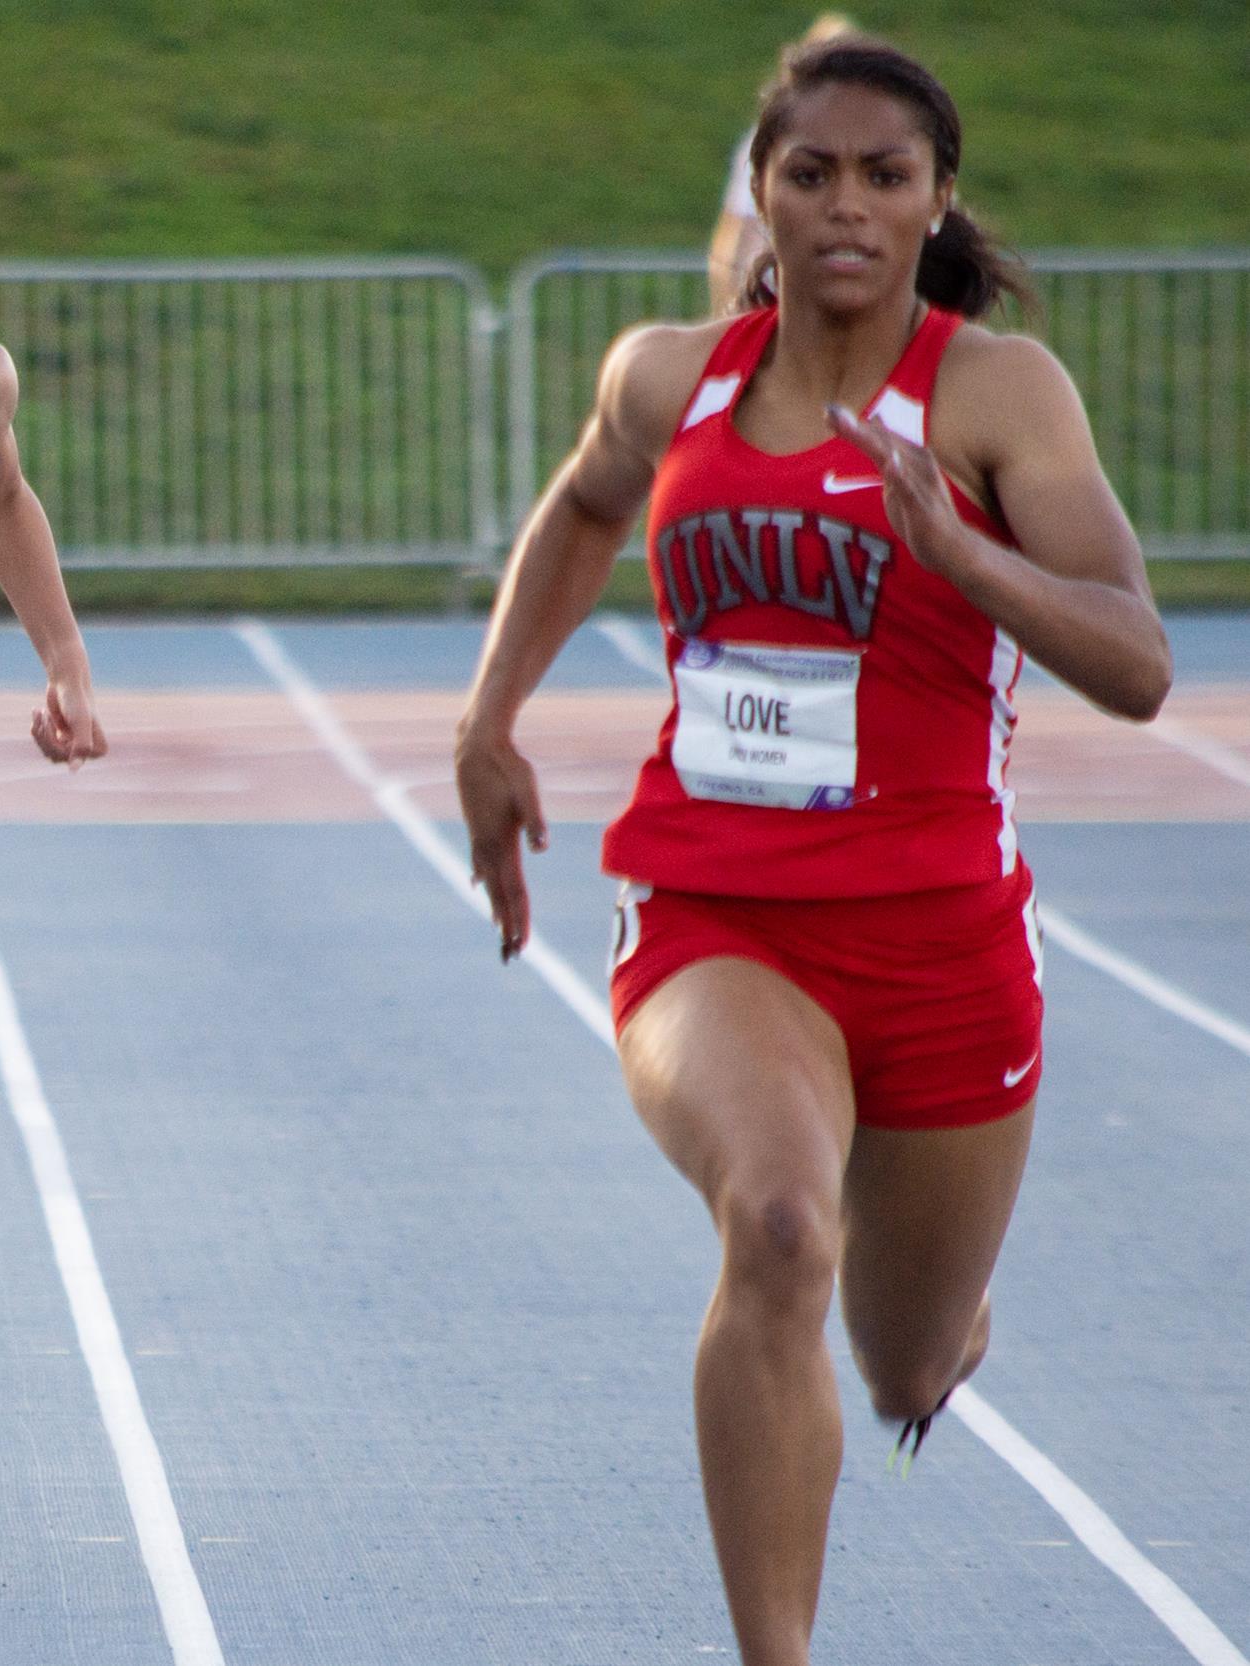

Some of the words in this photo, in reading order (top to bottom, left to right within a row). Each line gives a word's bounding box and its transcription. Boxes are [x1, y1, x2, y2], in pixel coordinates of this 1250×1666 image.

[657, 507, 892, 639] UNLV
[725, 691, 790, 736] LOVE
[749, 749, 788, 766] WOMEN
